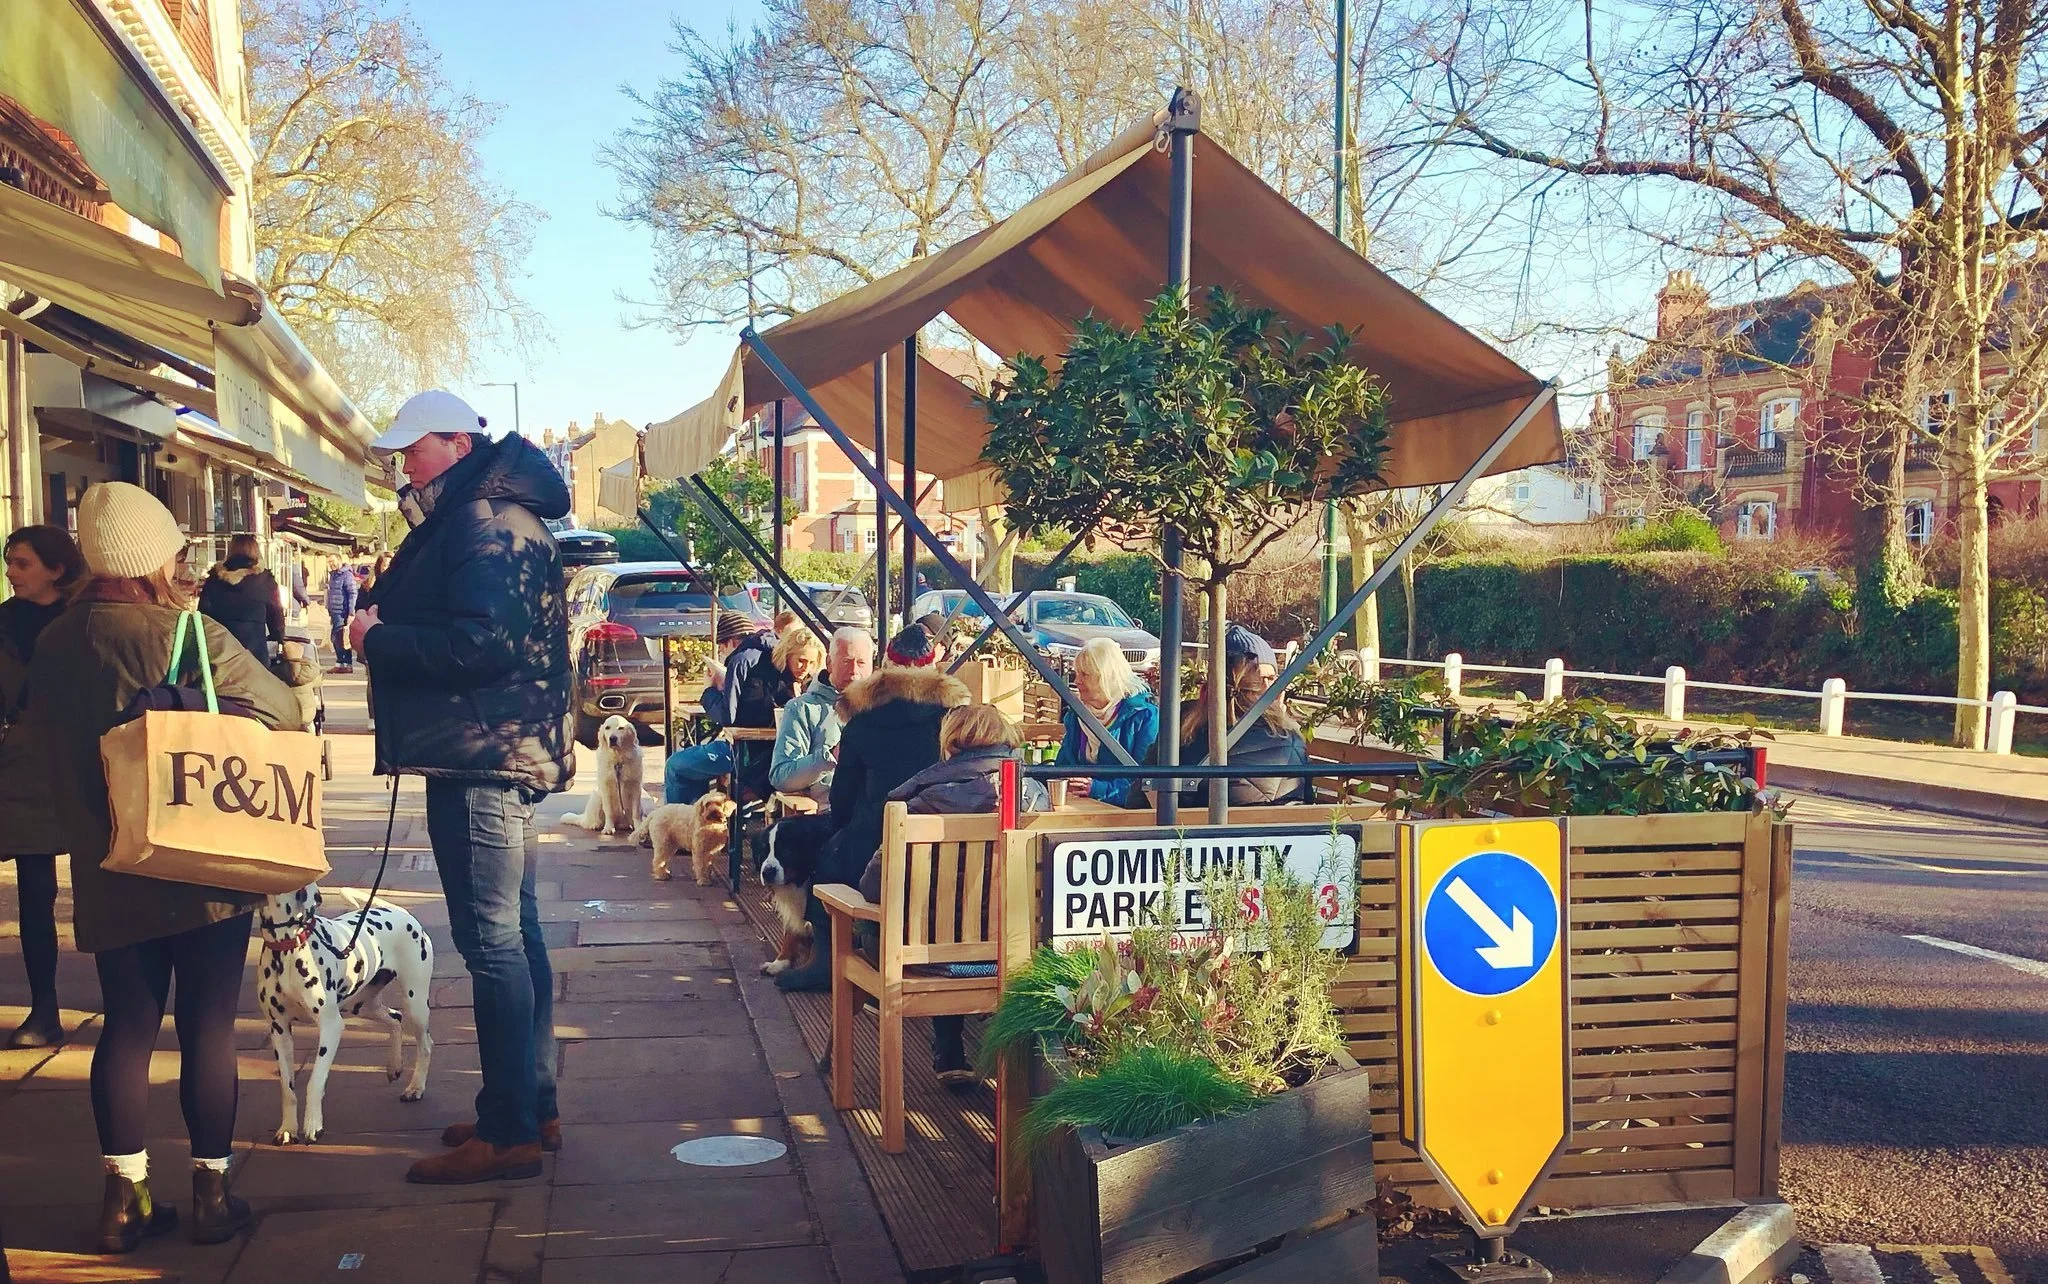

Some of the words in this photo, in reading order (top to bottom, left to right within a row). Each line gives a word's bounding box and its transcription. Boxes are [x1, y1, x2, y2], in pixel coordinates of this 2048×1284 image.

[164, 751, 317, 830] F&M
[1066, 844, 1292, 887] COMMUNITY
[1065, 889, 1226, 929] PARKE
[1238, 883, 1340, 923] S3
